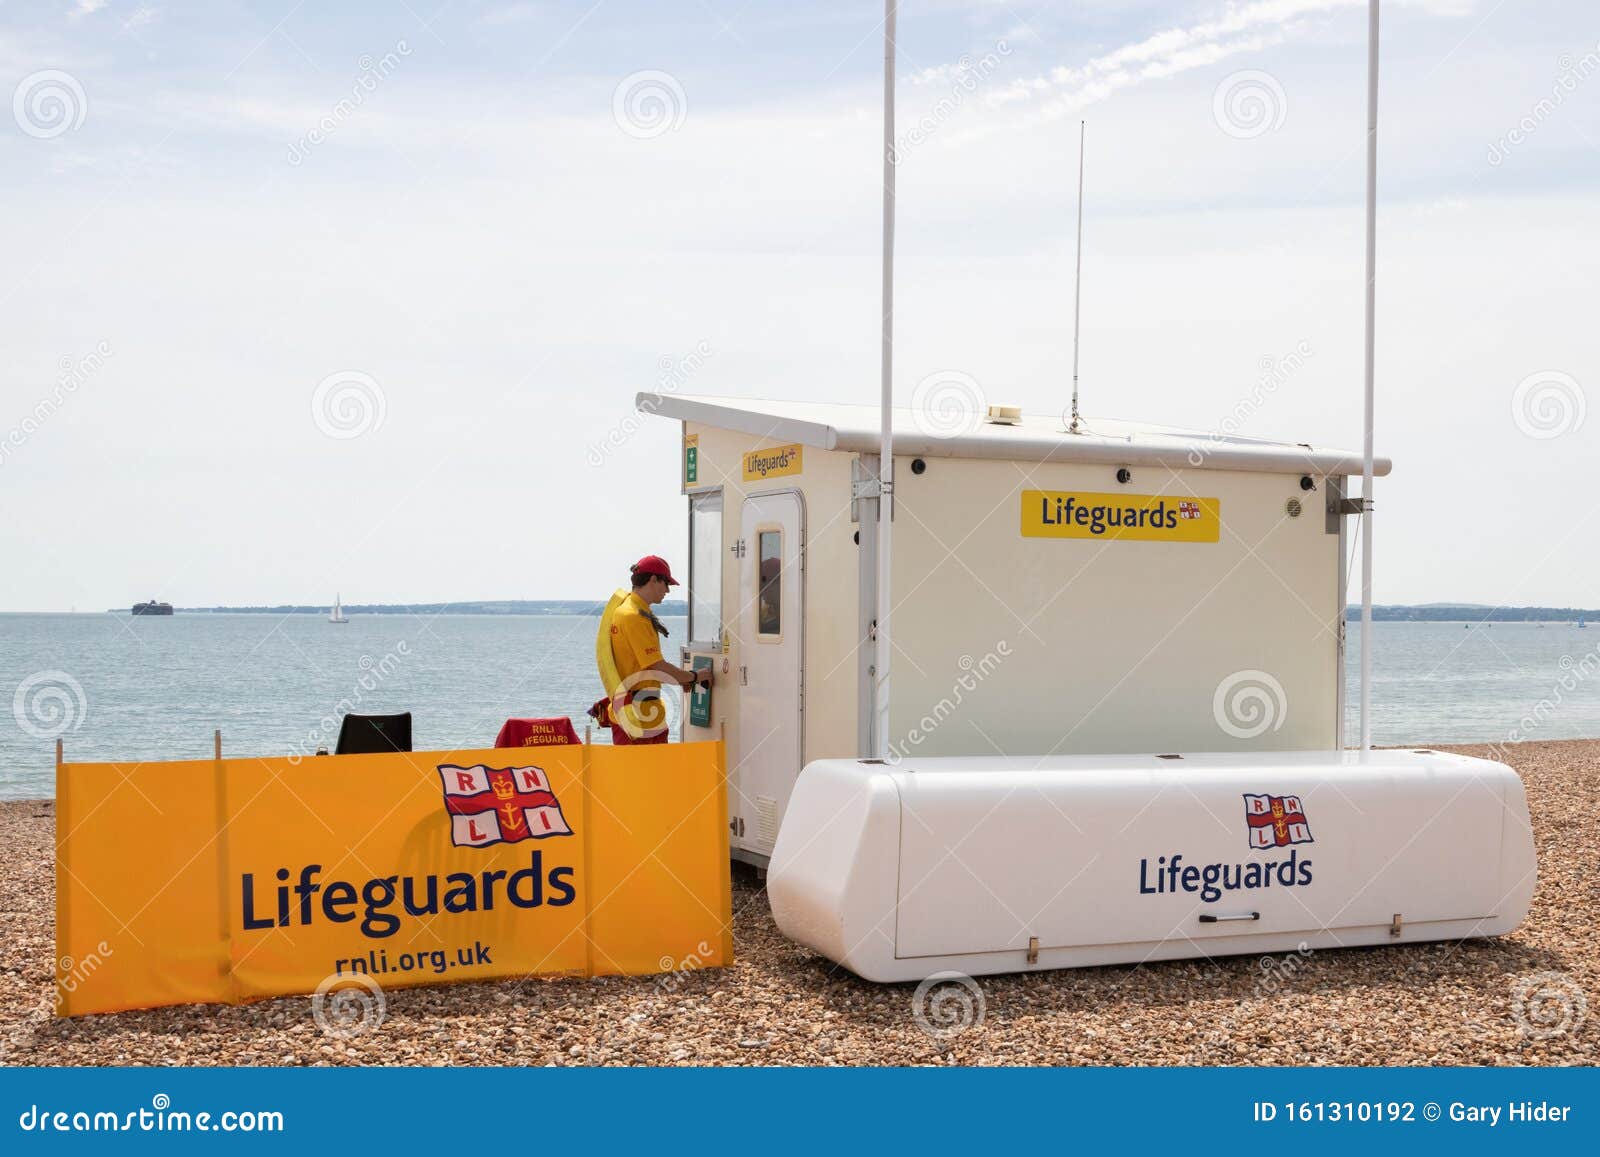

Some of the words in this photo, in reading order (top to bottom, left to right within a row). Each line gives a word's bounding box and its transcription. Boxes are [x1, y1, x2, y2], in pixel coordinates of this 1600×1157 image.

[748, 450, 789, 476] Lifeguards
[1042, 497, 1177, 535] Lifeguards
[533, 725, 555, 734] RNLI
[242, 850, 576, 938] Lifeguards
[1140, 849, 1313, 903] Lifeguards
[335, 941, 492, 977] rnli.org.uk
